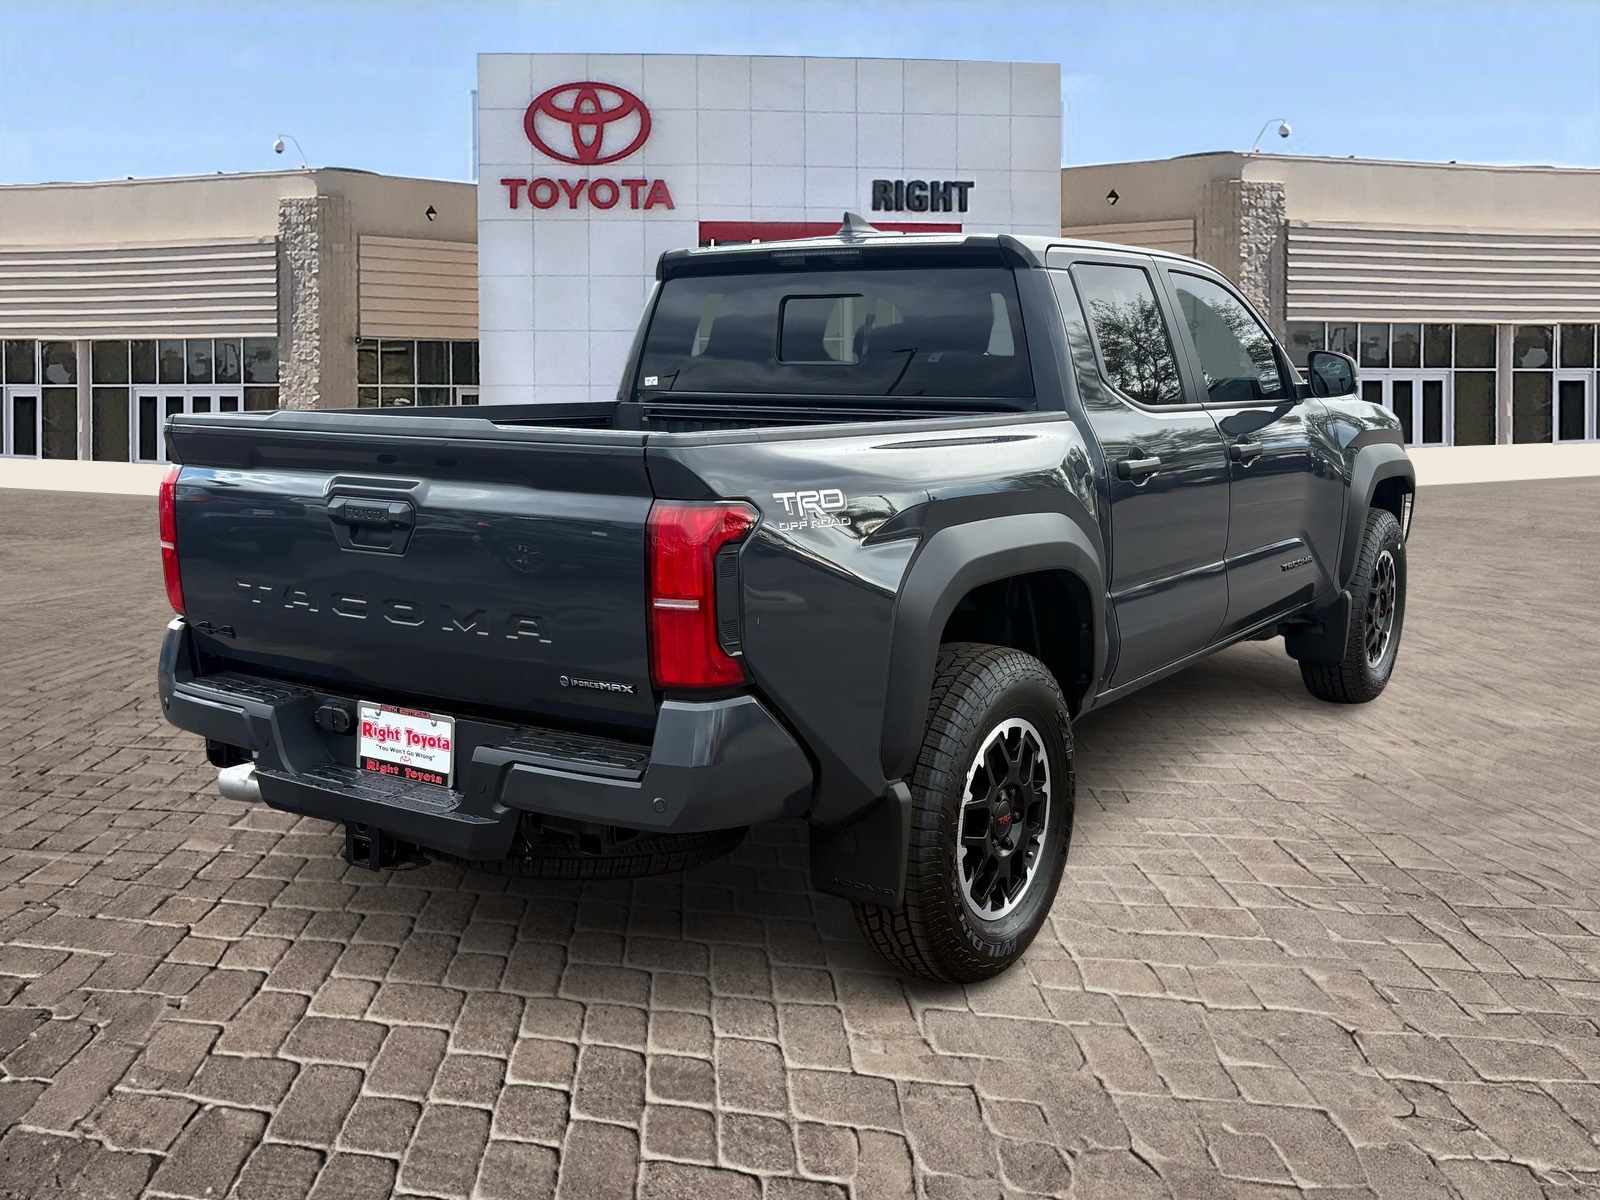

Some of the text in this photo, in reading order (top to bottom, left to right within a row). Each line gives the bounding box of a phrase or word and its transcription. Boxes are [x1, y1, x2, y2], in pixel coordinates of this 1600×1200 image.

[500, 178, 675, 209] TOYOTA
[872, 179, 975, 212] RIGHT
[772, 488, 848, 520] TRD
[779, 517, 852, 531] OFF ROAD
[235, 580, 553, 644] TACOMA
[362, 721, 451, 751] Right Toyota
[366, 758, 442, 783] Right Toyota
